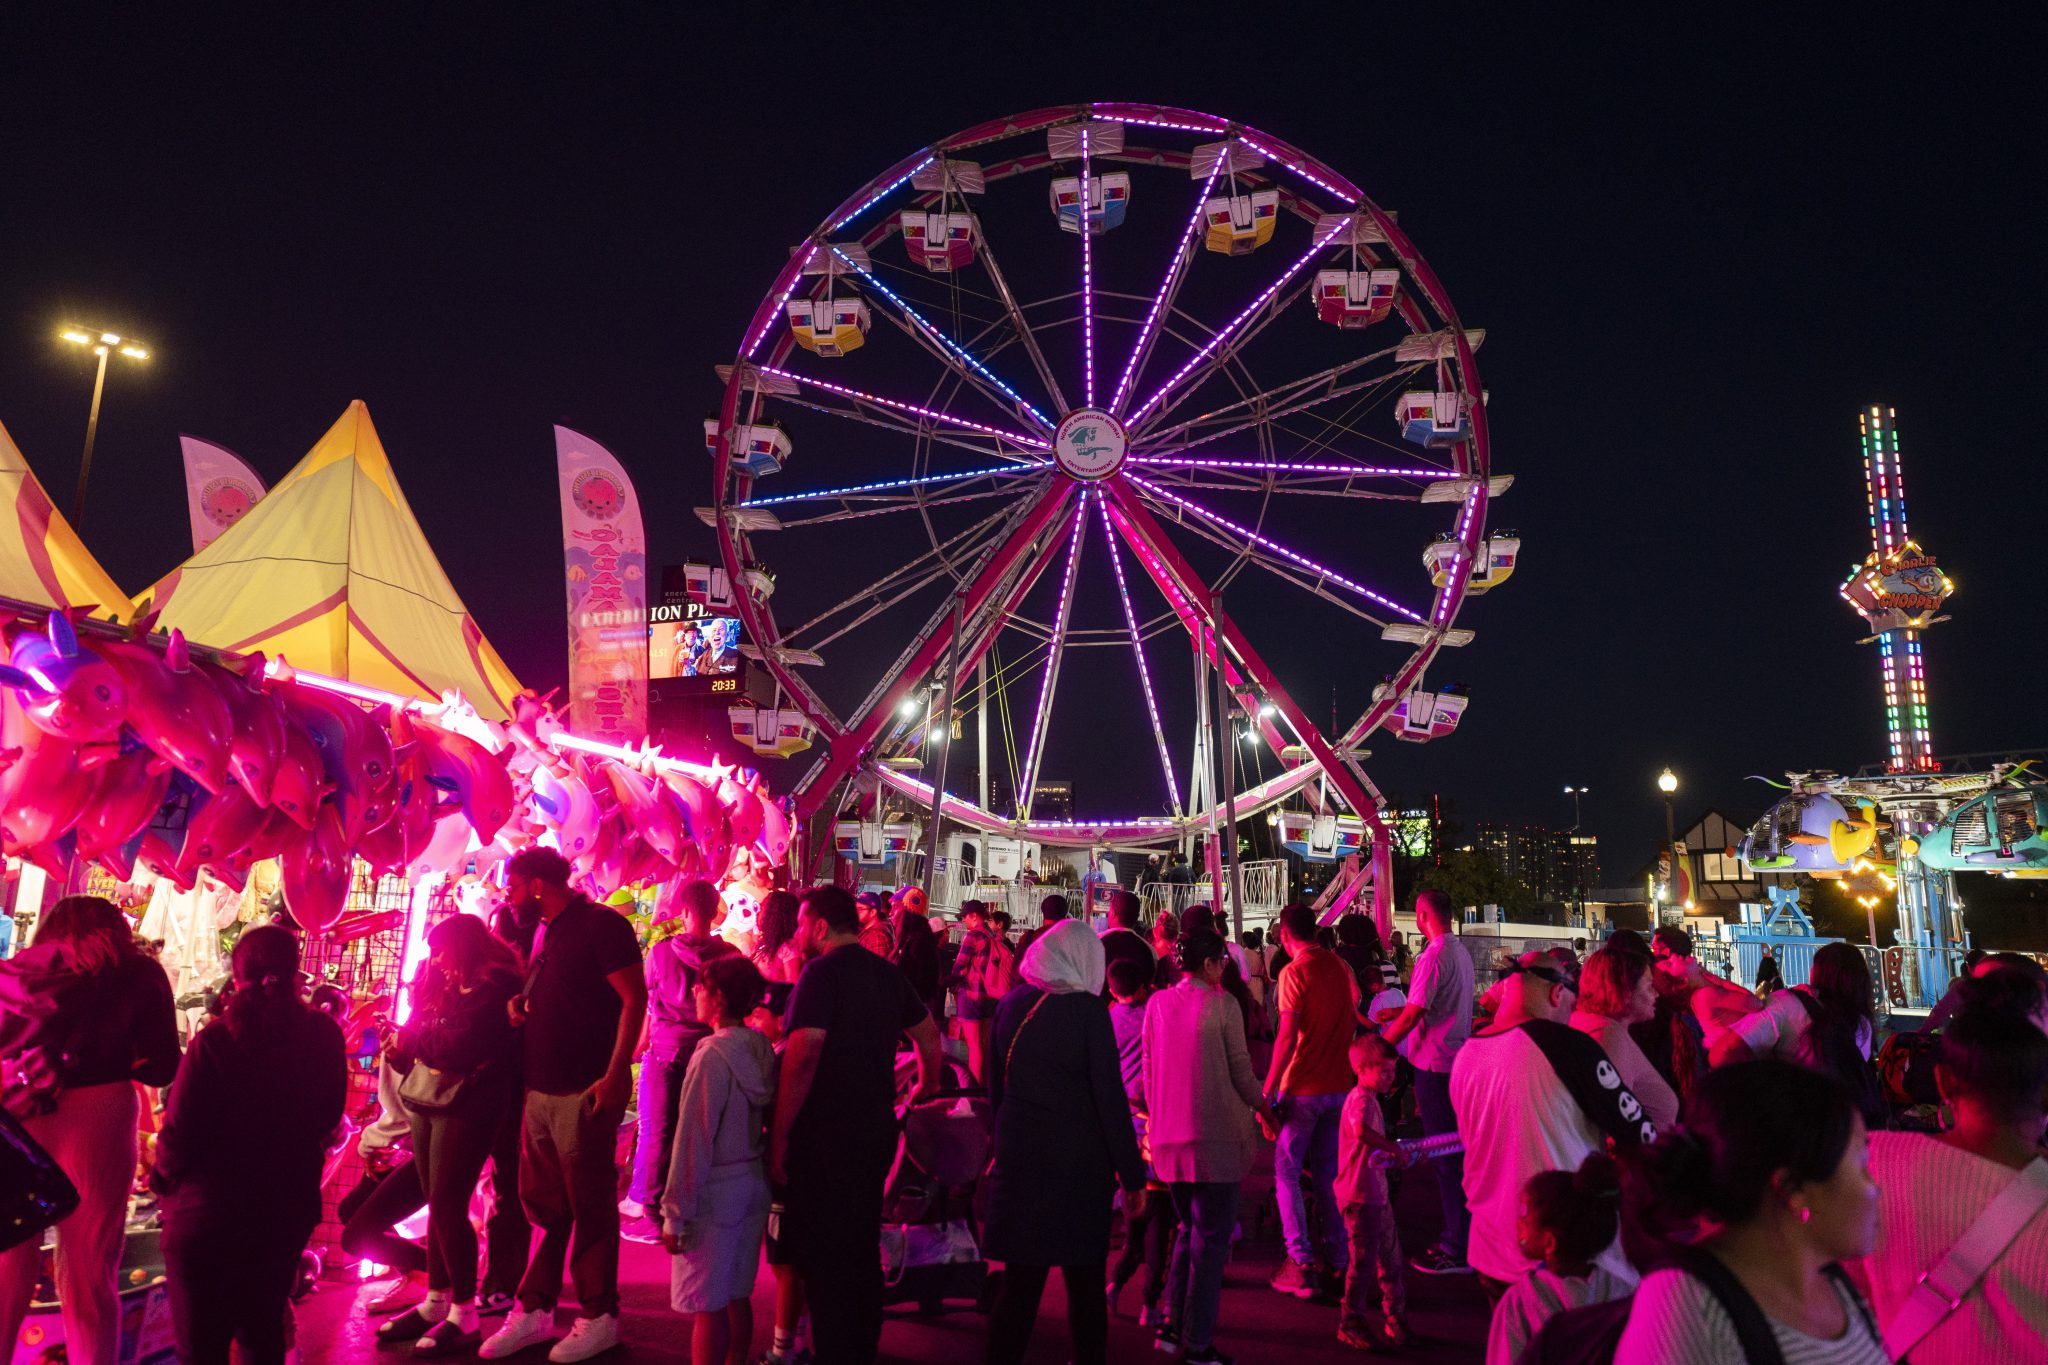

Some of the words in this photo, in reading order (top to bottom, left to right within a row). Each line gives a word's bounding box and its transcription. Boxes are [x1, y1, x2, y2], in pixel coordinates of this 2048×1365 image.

[1060, 421, 1074, 441] NORTH
[1073, 414, 1105, 424] AMERICAN
[1104, 419, 1121, 440] MIDWAY
[1066, 459, 1115, 474] ENTERTAINMENT
[1880, 555, 1938, 576] CHARLIE
[1878, 592, 1943, 610] CHOPPER
[687, 603, 713, 618] PL
[711, 679, 736, 692] 20:33
[1103, 890, 1112, 901] 5
